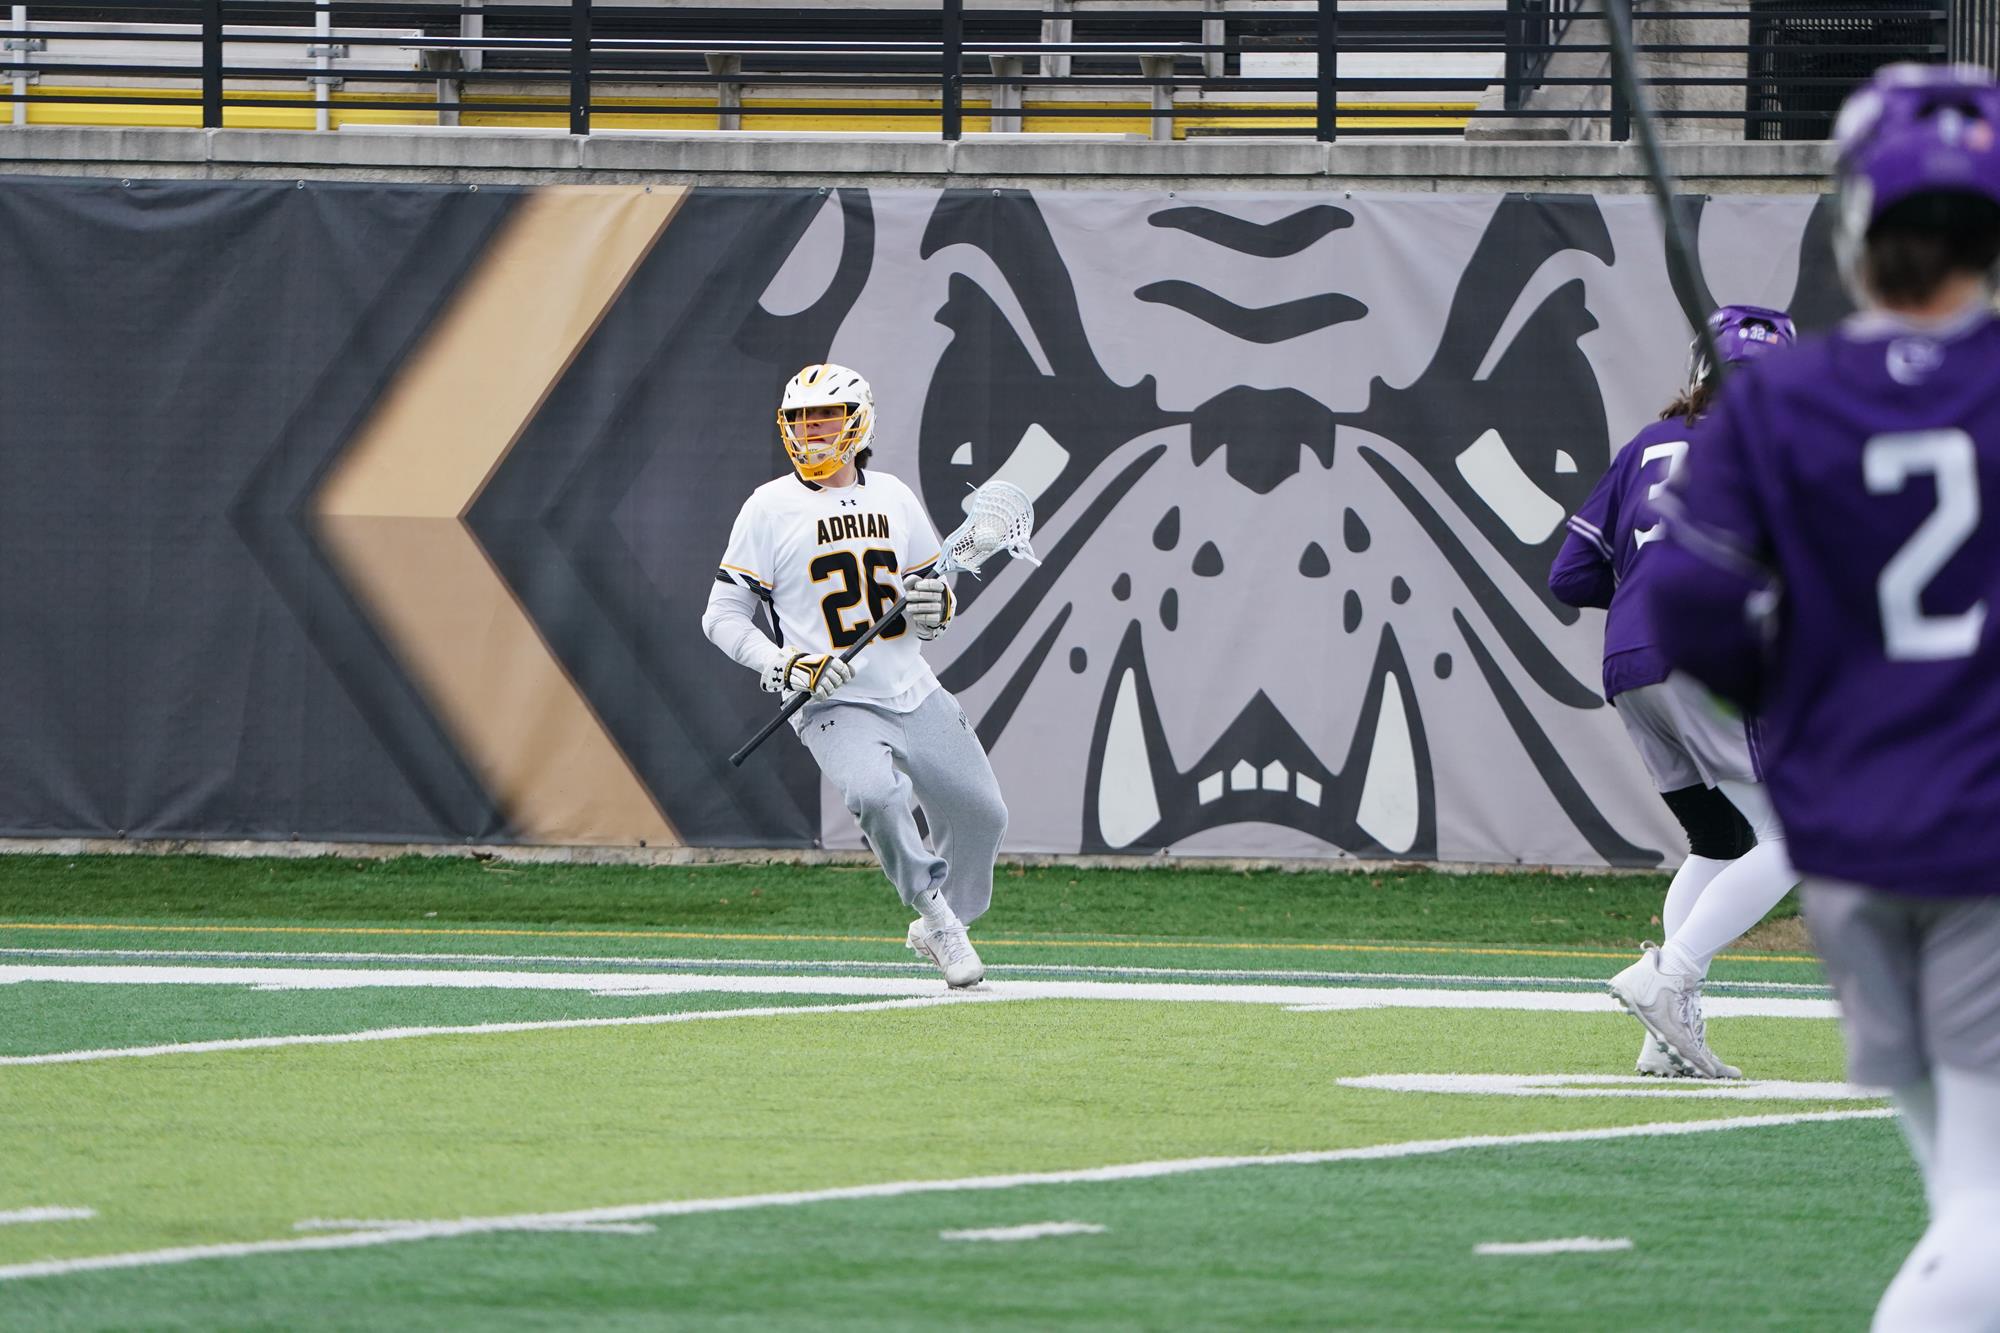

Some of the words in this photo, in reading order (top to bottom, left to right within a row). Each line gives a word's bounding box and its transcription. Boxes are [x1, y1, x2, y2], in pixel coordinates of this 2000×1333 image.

[817, 513, 890, 545] ADRIAN
[1861, 428, 1987, 662] 2
[808, 548, 907, 649] 26
